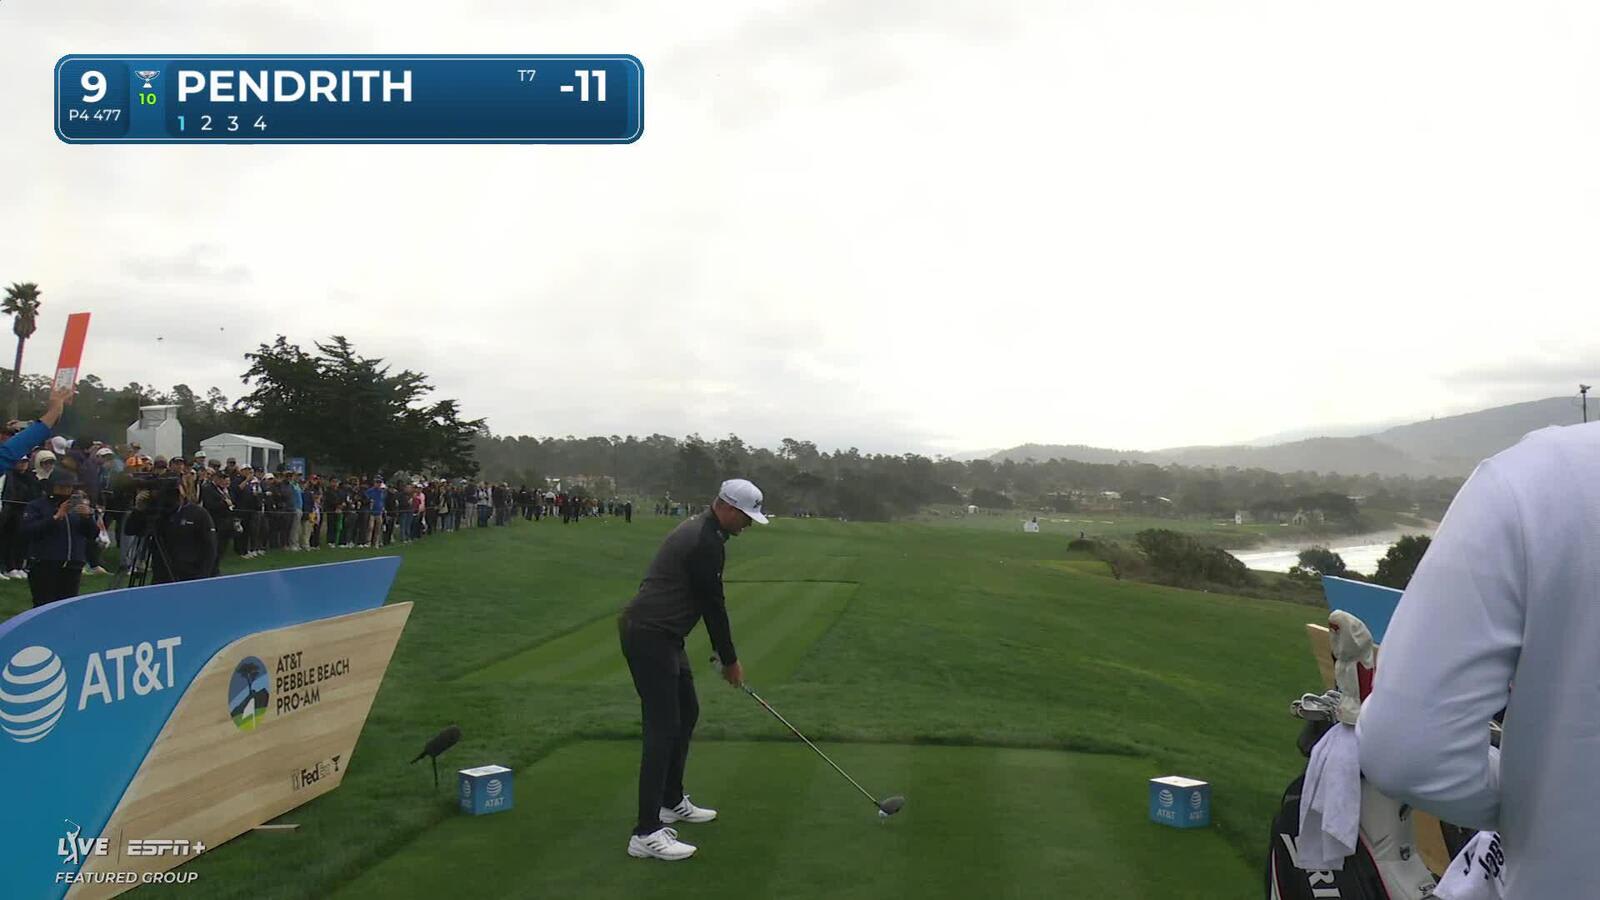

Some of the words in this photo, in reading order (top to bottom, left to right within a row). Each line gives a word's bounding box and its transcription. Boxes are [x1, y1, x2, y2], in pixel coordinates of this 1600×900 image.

[78, 636, 182, 711] AT&T
[276, 651, 303, 674] AT&T
[276, 667, 315, 695] PEBBLE
[317, 657, 350, 682] BEACH
[276, 686, 320, 716] PRO-AM
